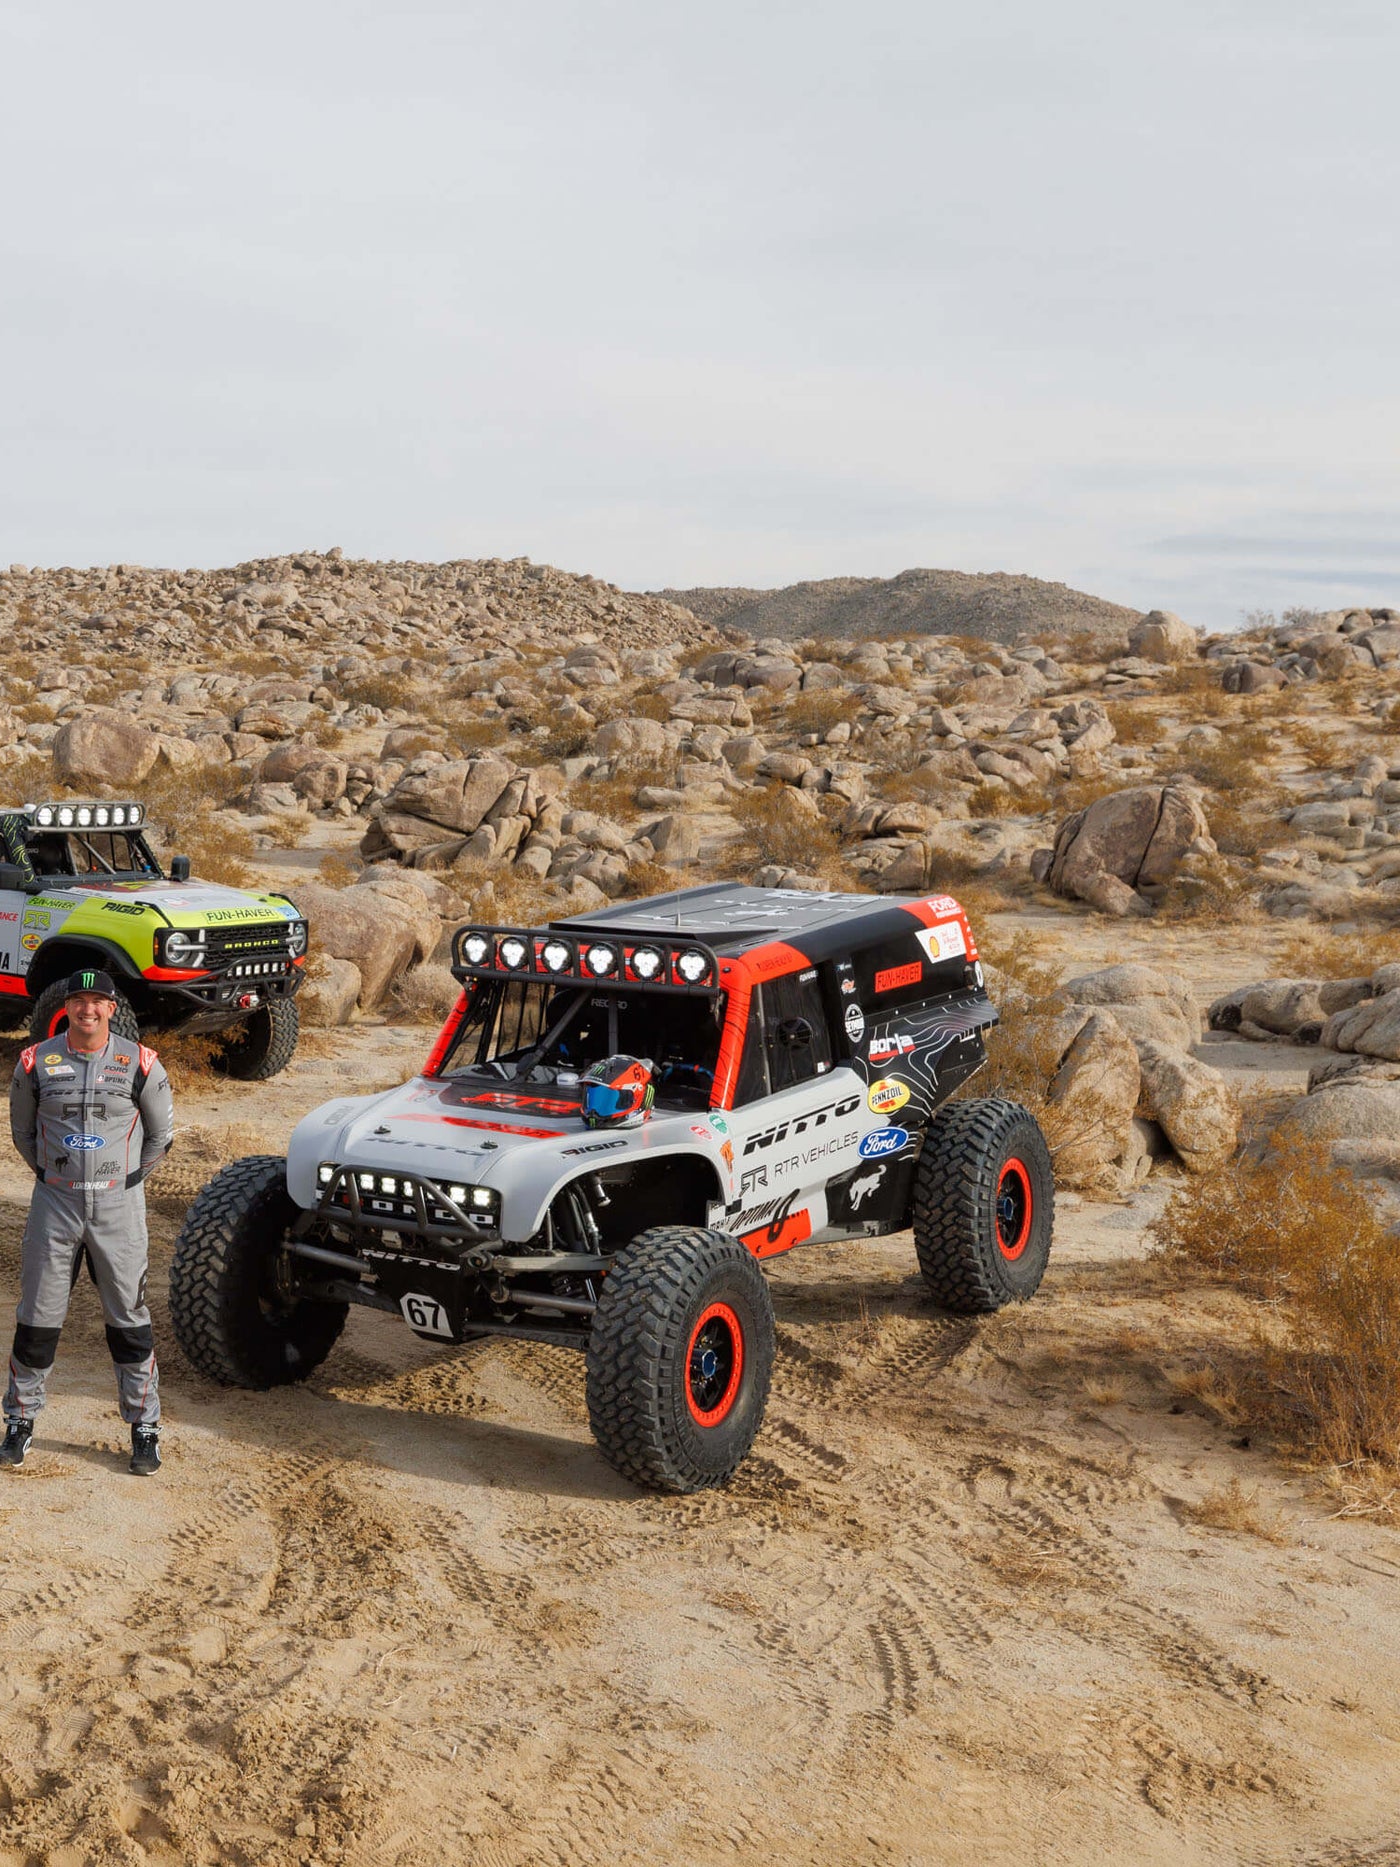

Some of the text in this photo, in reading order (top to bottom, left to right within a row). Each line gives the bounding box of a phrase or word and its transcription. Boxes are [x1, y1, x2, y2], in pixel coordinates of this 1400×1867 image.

[101, 902, 146, 915] RIGID
[206, 908, 273, 922] FUN-HAVER
[927, 897, 957, 913] FORD
[224, 939, 280, 949] BRONCO
[877, 964, 921, 989] FUN-HAVER
[591, 999, 628, 1010] RECRO
[871, 1086, 903, 1107] PENNZOIL
[743, 1094, 861, 1157] NITTO
[69, 1136, 99, 1148] Ford
[561, 1139, 628, 1158] RIGID
[863, 1131, 898, 1155] Ford
[774, 1155, 799, 1178] RTR
[801, 1131, 859, 1167] VEHICLES
[728, 1196, 782, 1233] OPTIMA
[361, 1248, 461, 1271] NITTO
[407, 1298, 440, 1330] 67
